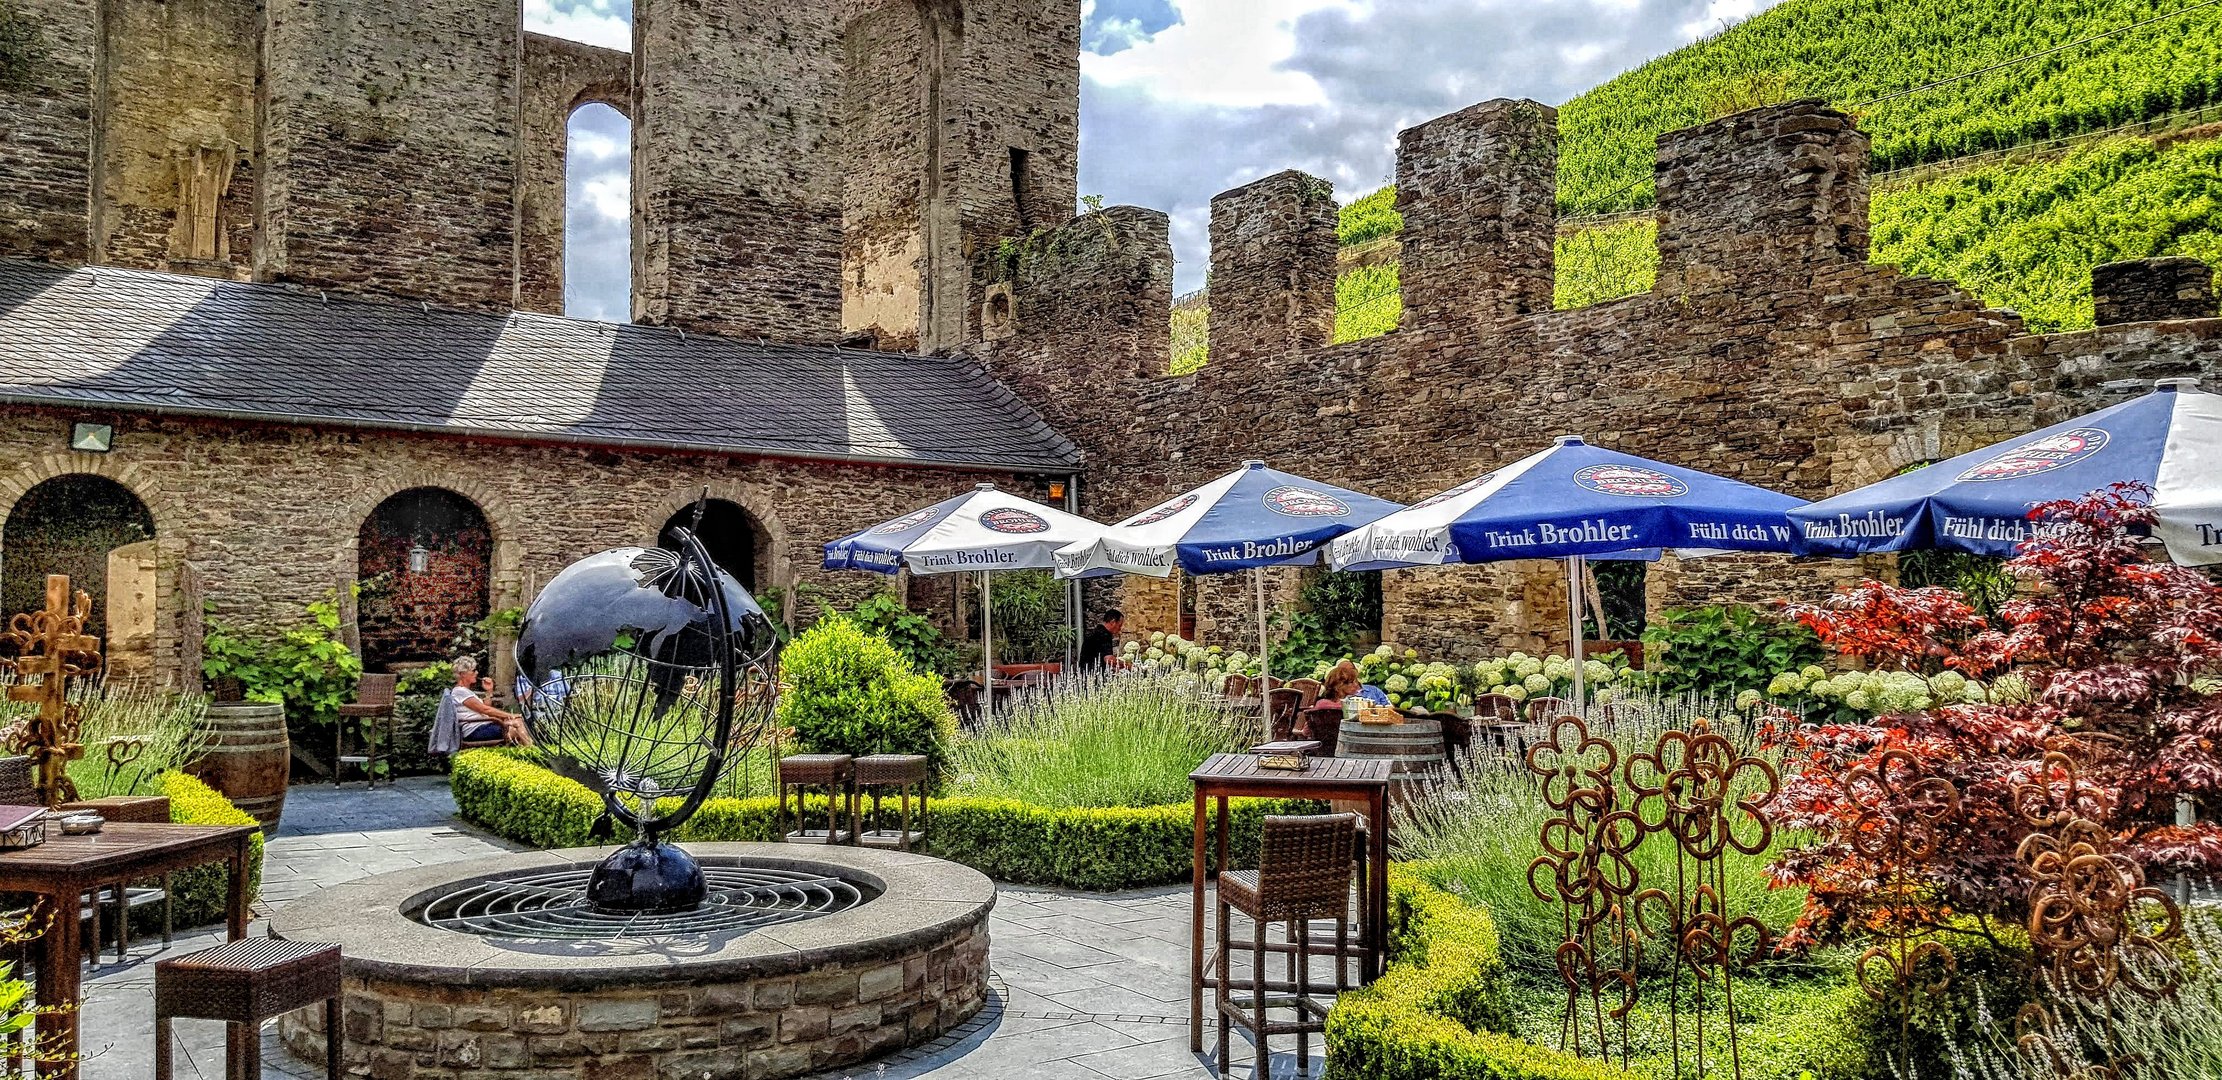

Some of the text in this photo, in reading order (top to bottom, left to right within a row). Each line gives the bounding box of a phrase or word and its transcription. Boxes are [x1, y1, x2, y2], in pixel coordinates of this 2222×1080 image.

[1485, 518, 1639, 548] Trink Brohler.
[1688, 522, 1729, 540] Fühl
[1731, 523, 1769, 542] dich
[1804, 510, 1905, 539] Trink Brohler.
[1942, 517, 1985, 539] Fühl
[1986, 519, 2024, 543] dich
[921, 548, 1018, 567] Trink Brohler.
[1115, 549, 1130, 565] dich
[1130, 547, 1170, 567] wohler.
[1202, 536, 1313, 562] Trink Brohler.
